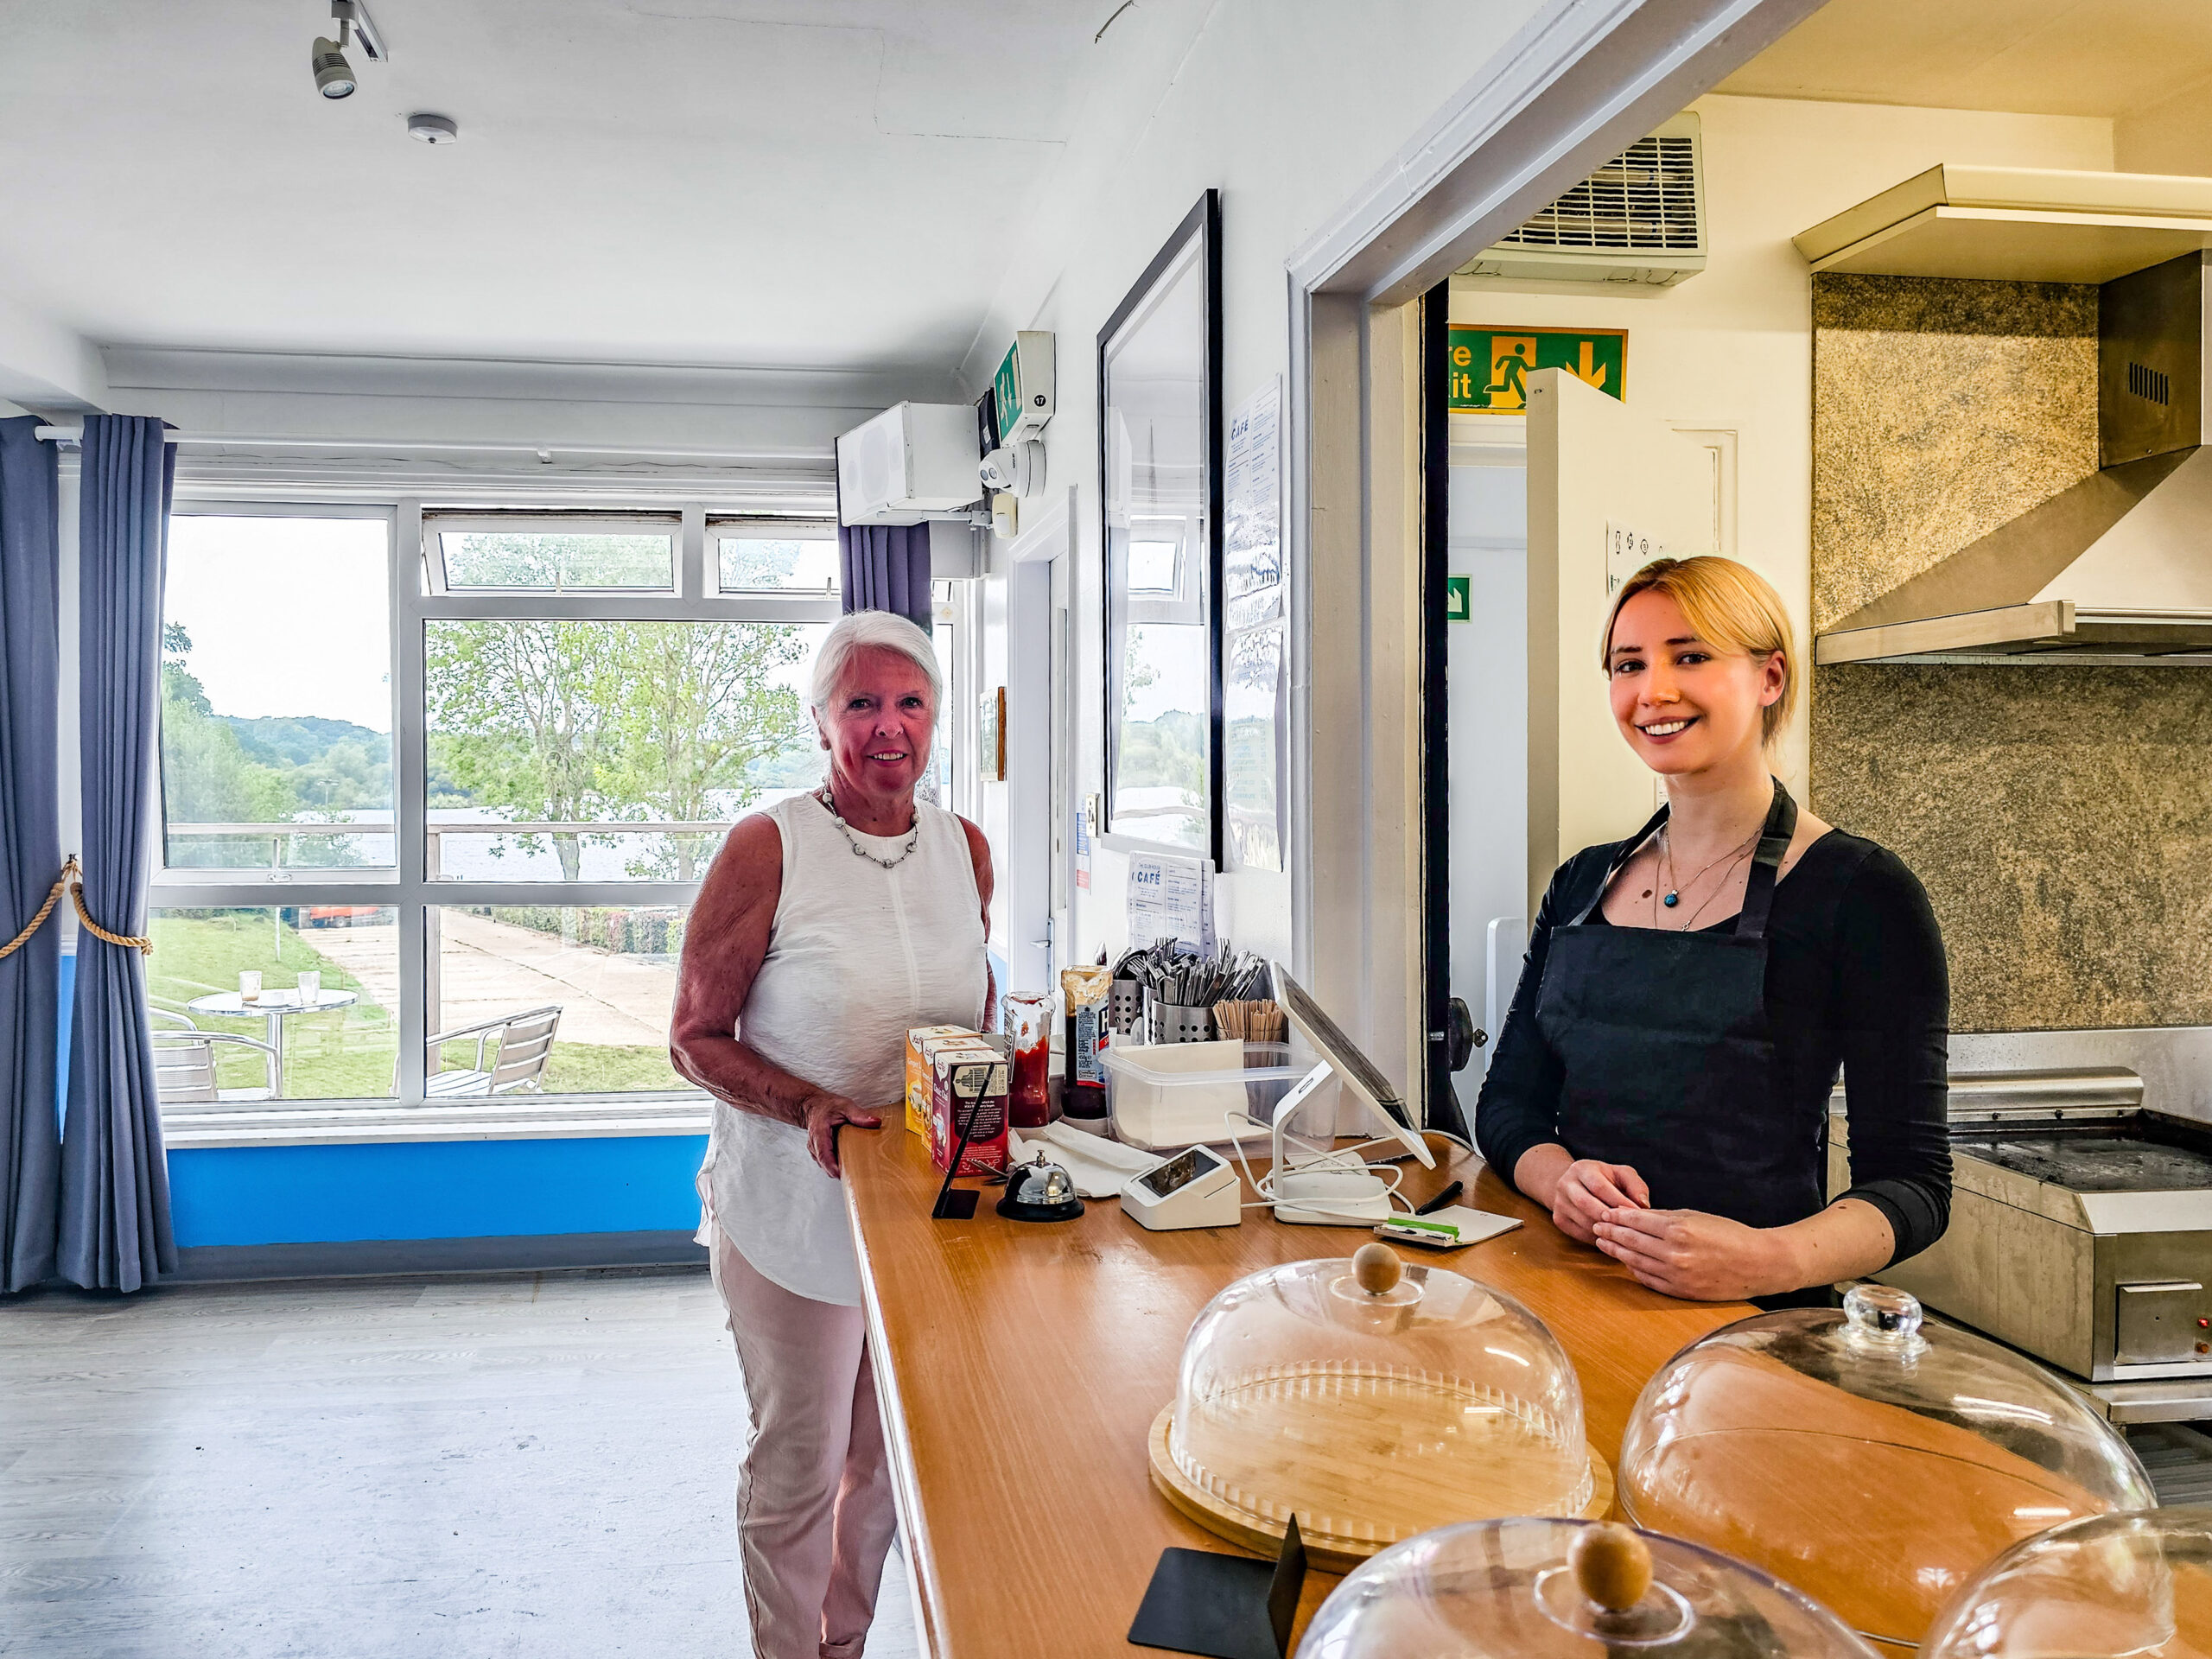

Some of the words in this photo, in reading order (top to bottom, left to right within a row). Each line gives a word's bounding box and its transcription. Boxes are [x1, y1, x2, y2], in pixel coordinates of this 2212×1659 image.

[1448, 346, 1471, 366] e
[1448, 372, 1471, 398] it
[1035, 397, 1045, 405] 17
[1230, 415, 1249, 441] CAFÉ
[1137, 871, 1160, 886] CAFÉ
[1101, 1009, 1109, 1033] H
